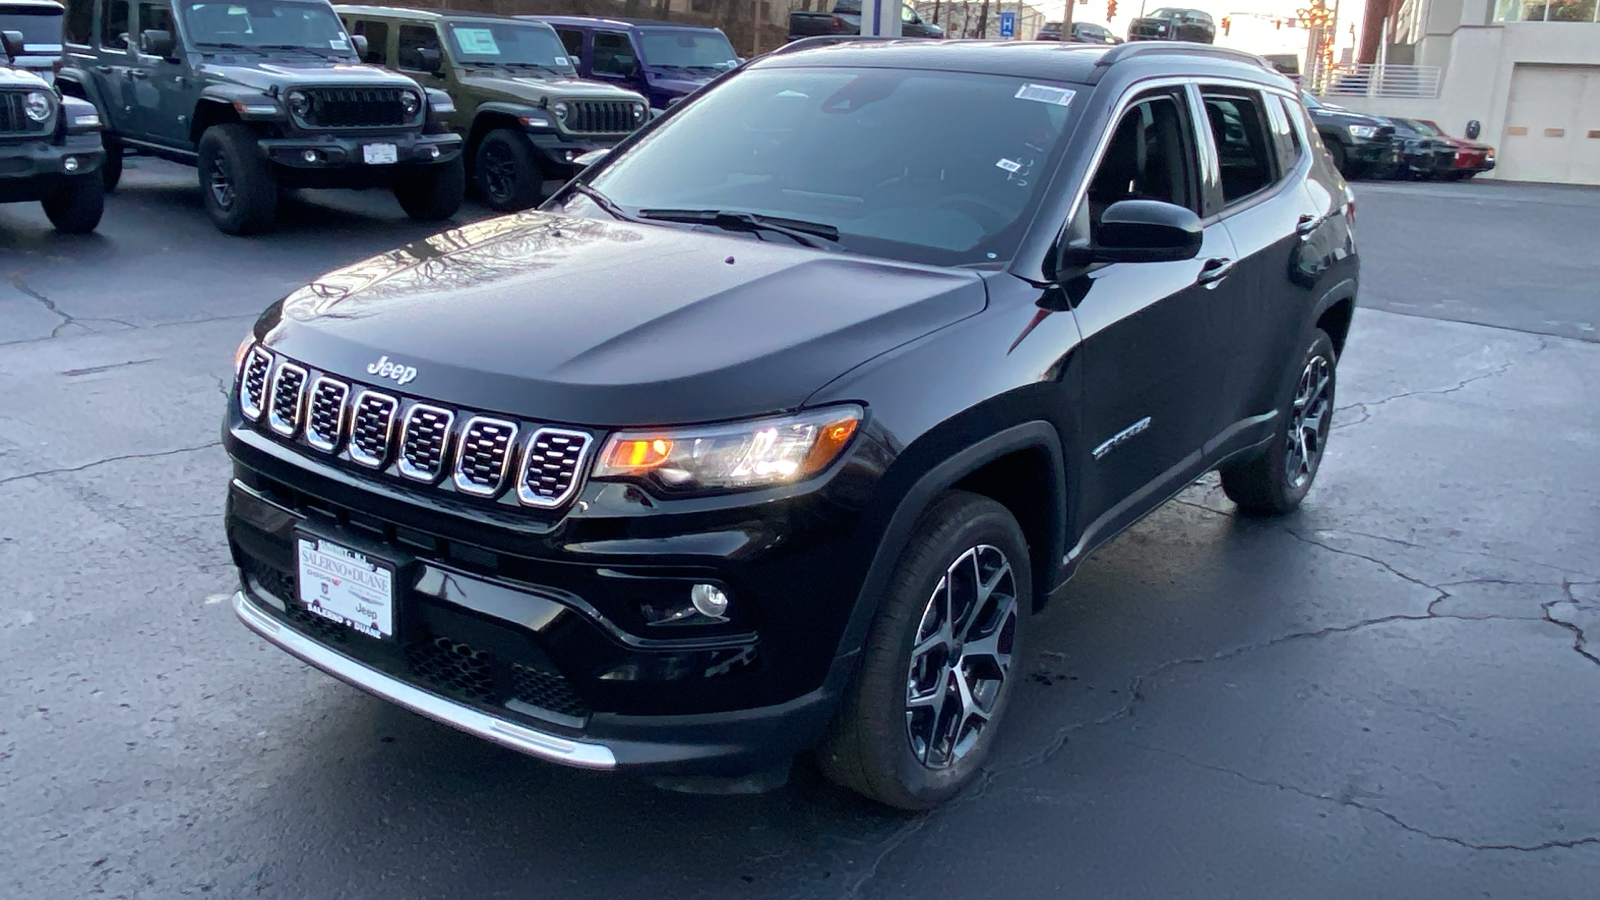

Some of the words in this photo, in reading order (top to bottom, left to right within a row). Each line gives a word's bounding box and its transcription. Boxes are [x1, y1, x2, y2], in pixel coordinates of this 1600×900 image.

[1003, 17, 1012, 30] H
[367, 355, 418, 385] Jeep
[302, 549, 348, 577] SALERNO
[352, 567, 389, 593] DUANE
[355, 602, 378, 620] Jeep
